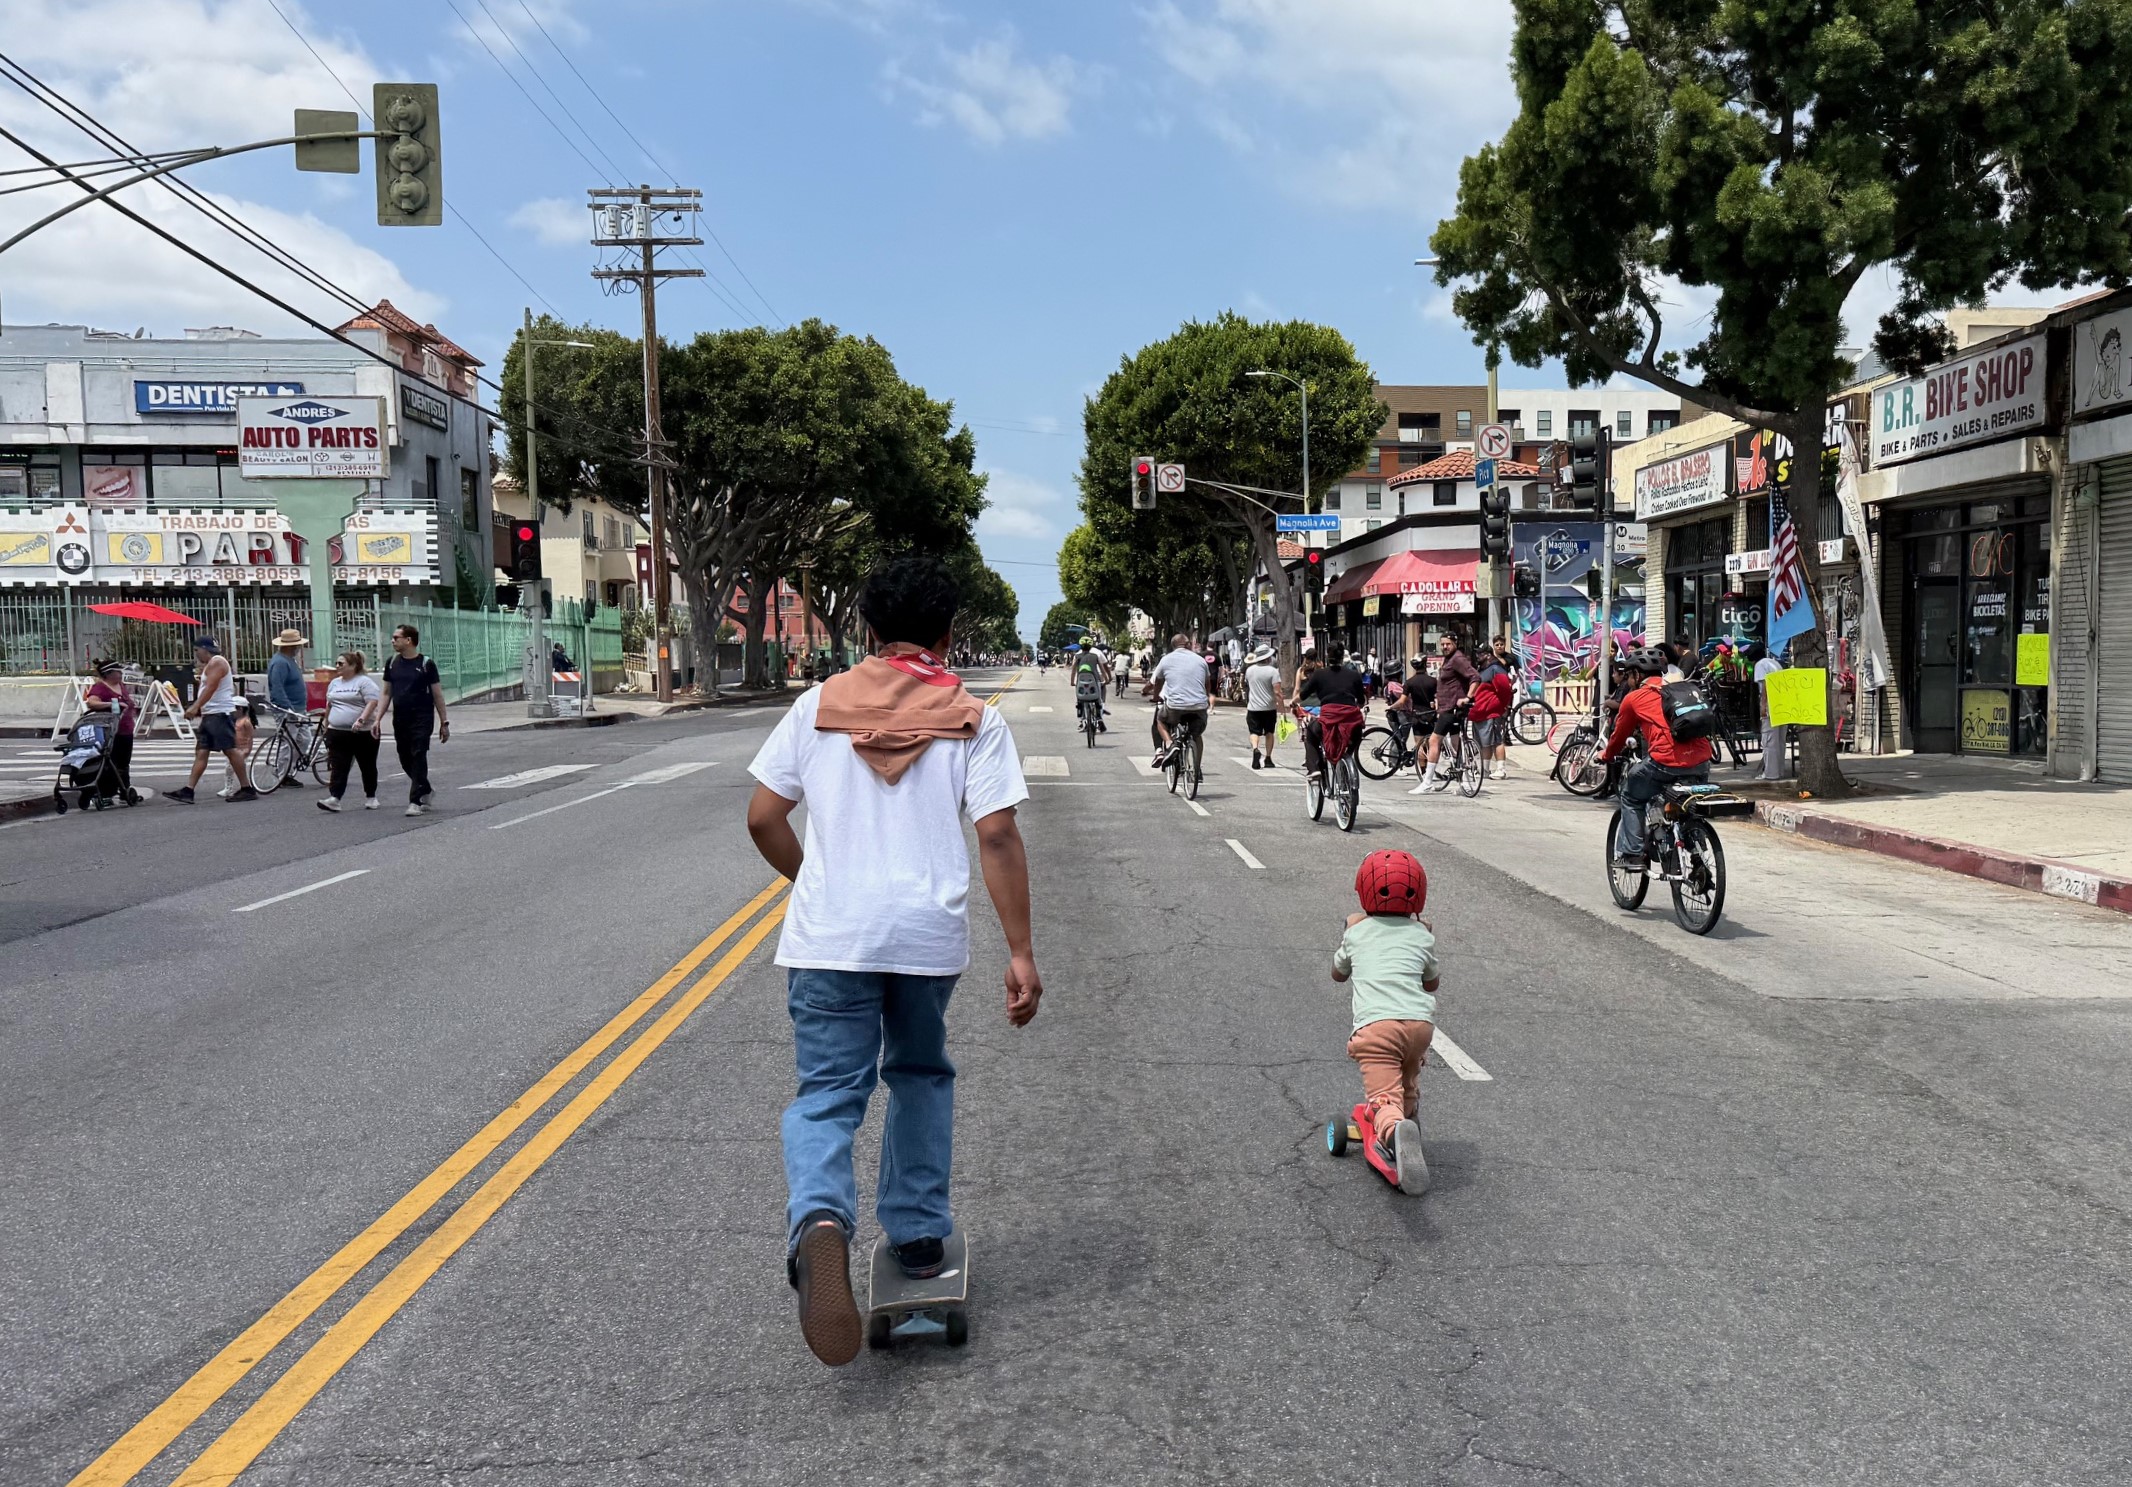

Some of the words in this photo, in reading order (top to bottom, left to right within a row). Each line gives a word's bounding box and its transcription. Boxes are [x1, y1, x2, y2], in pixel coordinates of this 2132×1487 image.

[148, 385, 269, 405] DENTISTA
[1883, 385, 1920, 433] B.R.
[1925, 366, 1969, 421] BIKE
[1974, 346, 2034, 407] SHOP
[411, 391, 446, 420] DENTISTA
[282, 407, 336, 418] ANDRES
[1881, 440, 1899, 457] BIKE
[1910, 431, 1938, 450] PARTS
[1952, 417, 1981, 439] SALES
[1983, 419, 1989, 430] &
[1991, 403, 2035, 429] REPAIRS
[243, 427, 300, 448] AUTO
[308, 427, 378, 448] PARTS
[1647, 463, 1671, 490] POLLOS
[1671, 463, 1680, 483] EL
[1680, 452, 1711, 481] BRASERO
[1665, 496, 1679, 511] Cooked
[1679, 493, 1688, 507] Over
[1688, 490, 1707, 505] Firewood
[159, 516, 243, 529] TRABAJO
[254, 516, 277, 529] DE
[1279, 518, 1318, 531] Magnolia
[1320, 518, 1337, 527] Ave
[1617, 527, 1627, 537] M
[1548, 541, 1578, 551] Magnolia
[171, 567, 300, 580] 213-386-8059
[1419, 580, 1461, 592] DOLLAR
[1421, 592, 1456, 601] GRAND
[1416, 602, 1460, 612] OPENING
[1973, 603, 2006, 618] BICICLETAS
[1722, 606, 1761, 631] tigo
[2025, 608, 2041, 621] BIKE
